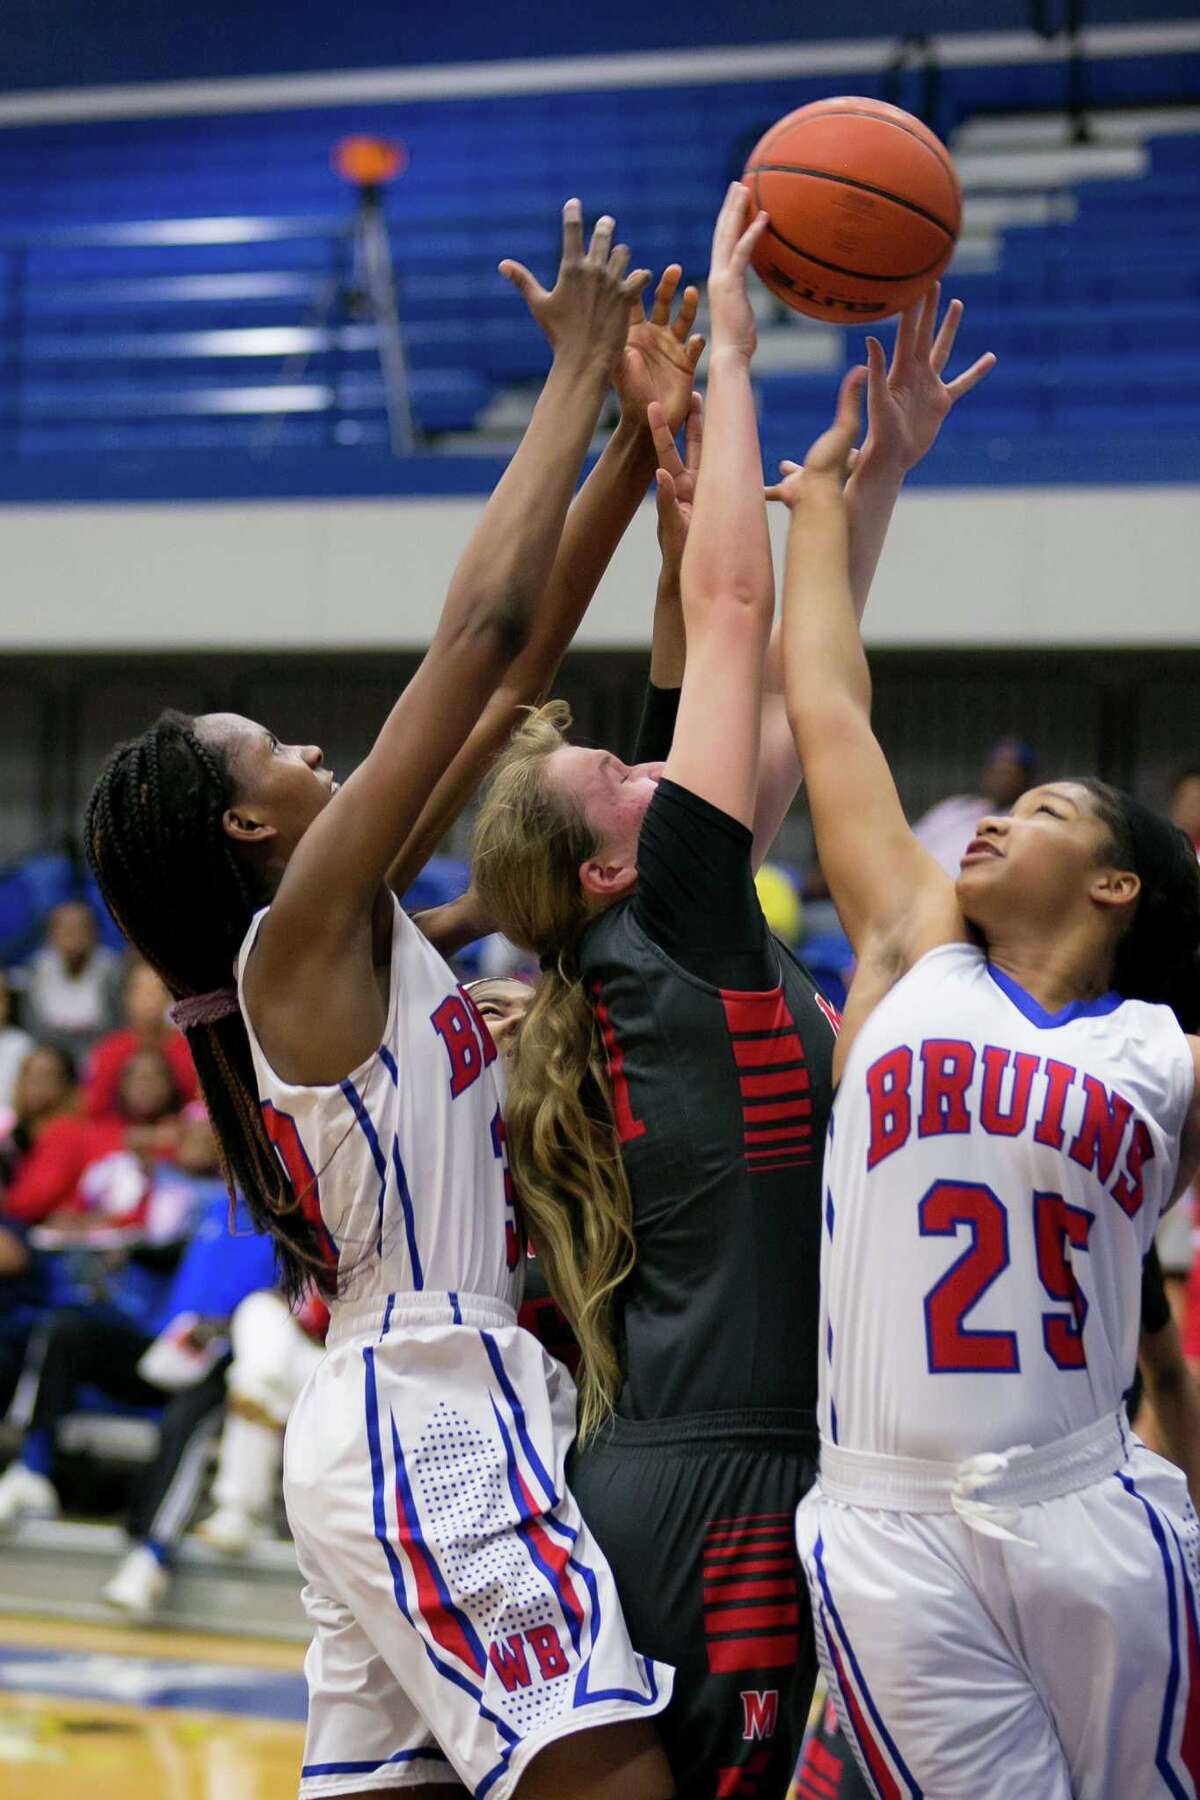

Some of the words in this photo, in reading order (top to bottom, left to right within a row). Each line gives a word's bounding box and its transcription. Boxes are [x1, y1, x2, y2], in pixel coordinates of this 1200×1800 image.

[866, 1038, 1155, 1220] BRUINS
[917, 1178, 1096, 1374] 25
[488, 1622, 571, 1694] WB
[739, 1689, 779, 1741] M
